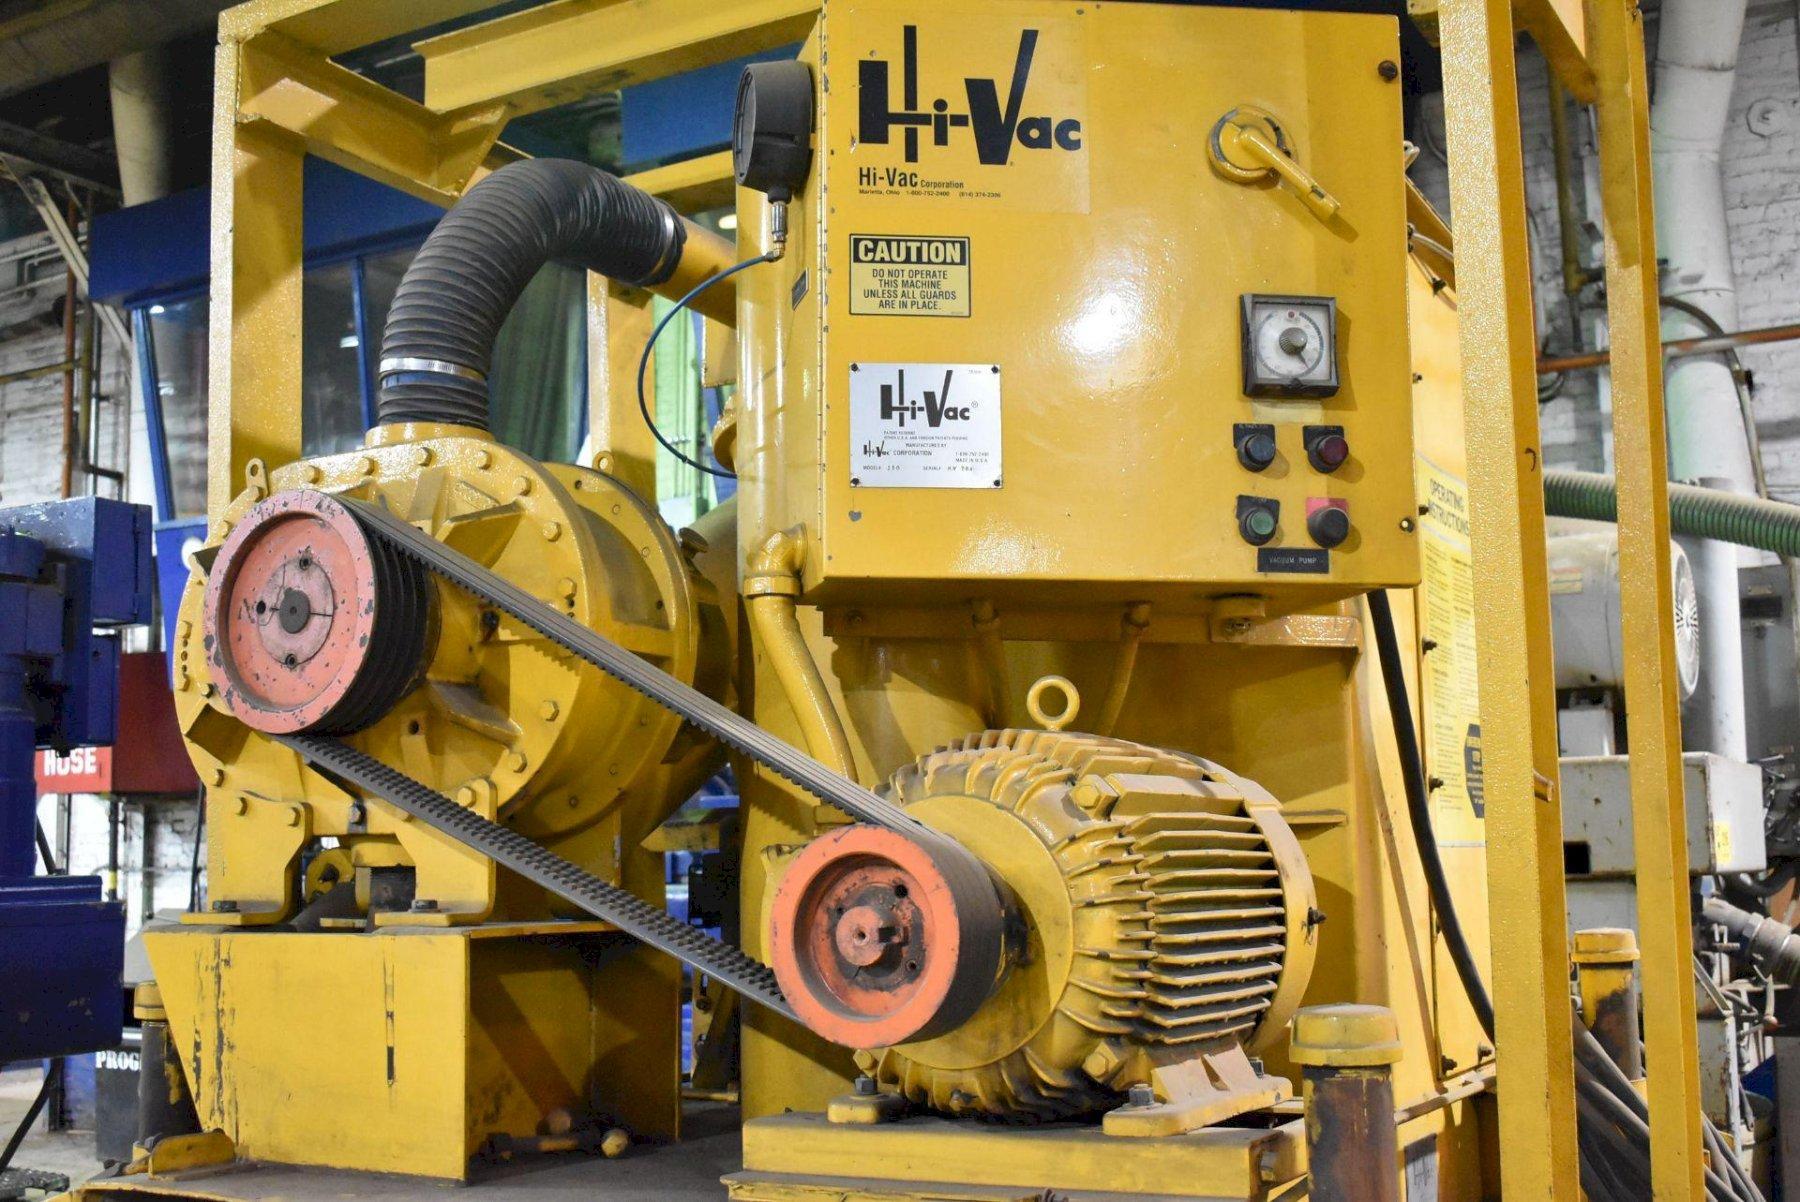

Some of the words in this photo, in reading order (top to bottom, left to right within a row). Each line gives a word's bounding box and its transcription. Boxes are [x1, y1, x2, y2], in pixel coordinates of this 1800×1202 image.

[858, 25, 1082, 166] Hi-Vac
[859, 167, 918, 188] Hi-Vac
[920, 180, 965, 189] Corporation
[858, 239, 961, 264] CAUTION
[872, 268, 885, 278] DO
[887, 269, 905, 279] NOT
[908, 269, 948, 280] OPERATE
[878, 279, 899, 289] THIS
[901, 279, 942, 290] MACHINE
[863, 289, 898, 299] UNLESS
[900, 289, 916, 300] ALL
[919, 290, 957, 301] GUARDS
[878, 299, 895, 309] ARE
[898, 300, 908, 310] IN
[910, 300, 942, 311] PLACE.
[1427, 498, 1469, 537] NSTRUCTIONS
[1269, 556, 1295, 564] VACUUM
[1298, 556, 1317, 564] PUMP
[95, 1050, 142, 1072] PROG
